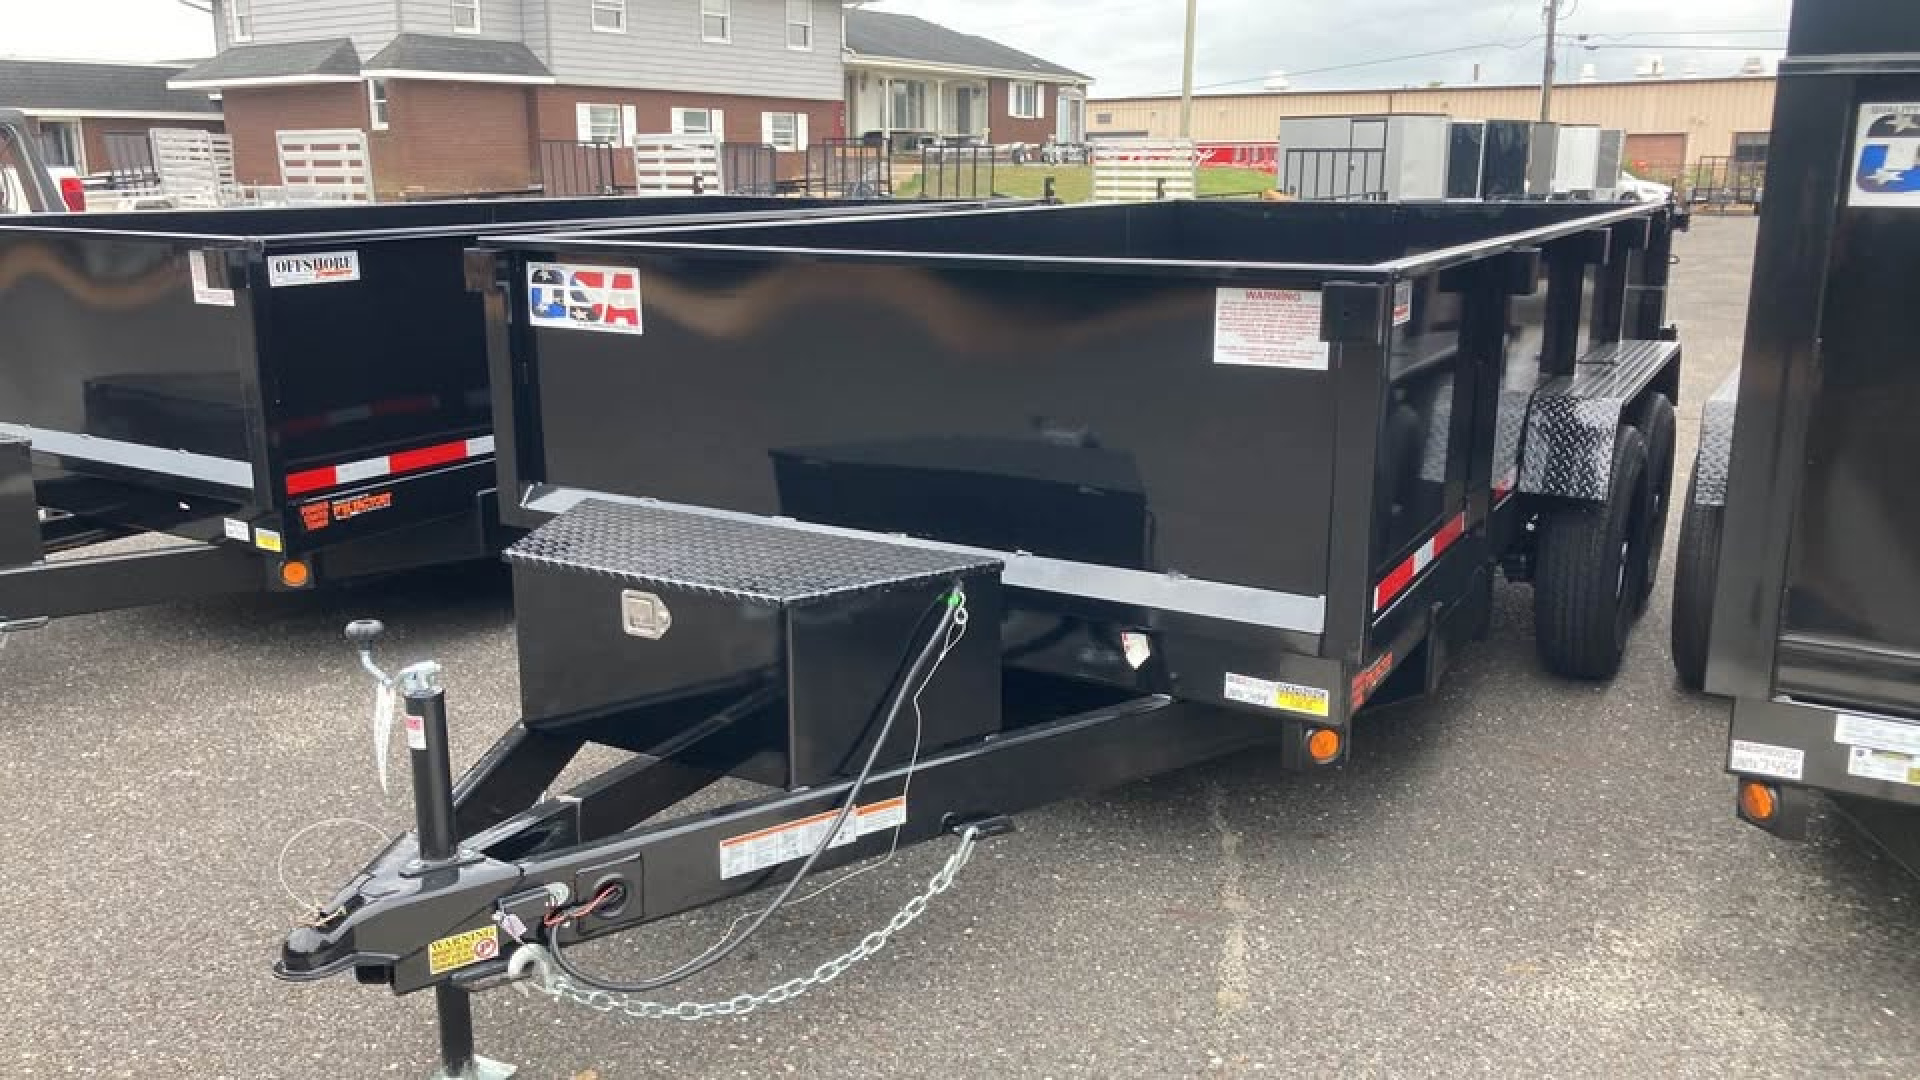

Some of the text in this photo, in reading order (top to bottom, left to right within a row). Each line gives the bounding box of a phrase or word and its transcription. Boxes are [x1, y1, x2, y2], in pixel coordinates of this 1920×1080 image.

[275, 255, 352, 273] OFFSHORE
[1246, 290, 1302, 302] WARNING
[431, 928, 496, 951] WARNING
